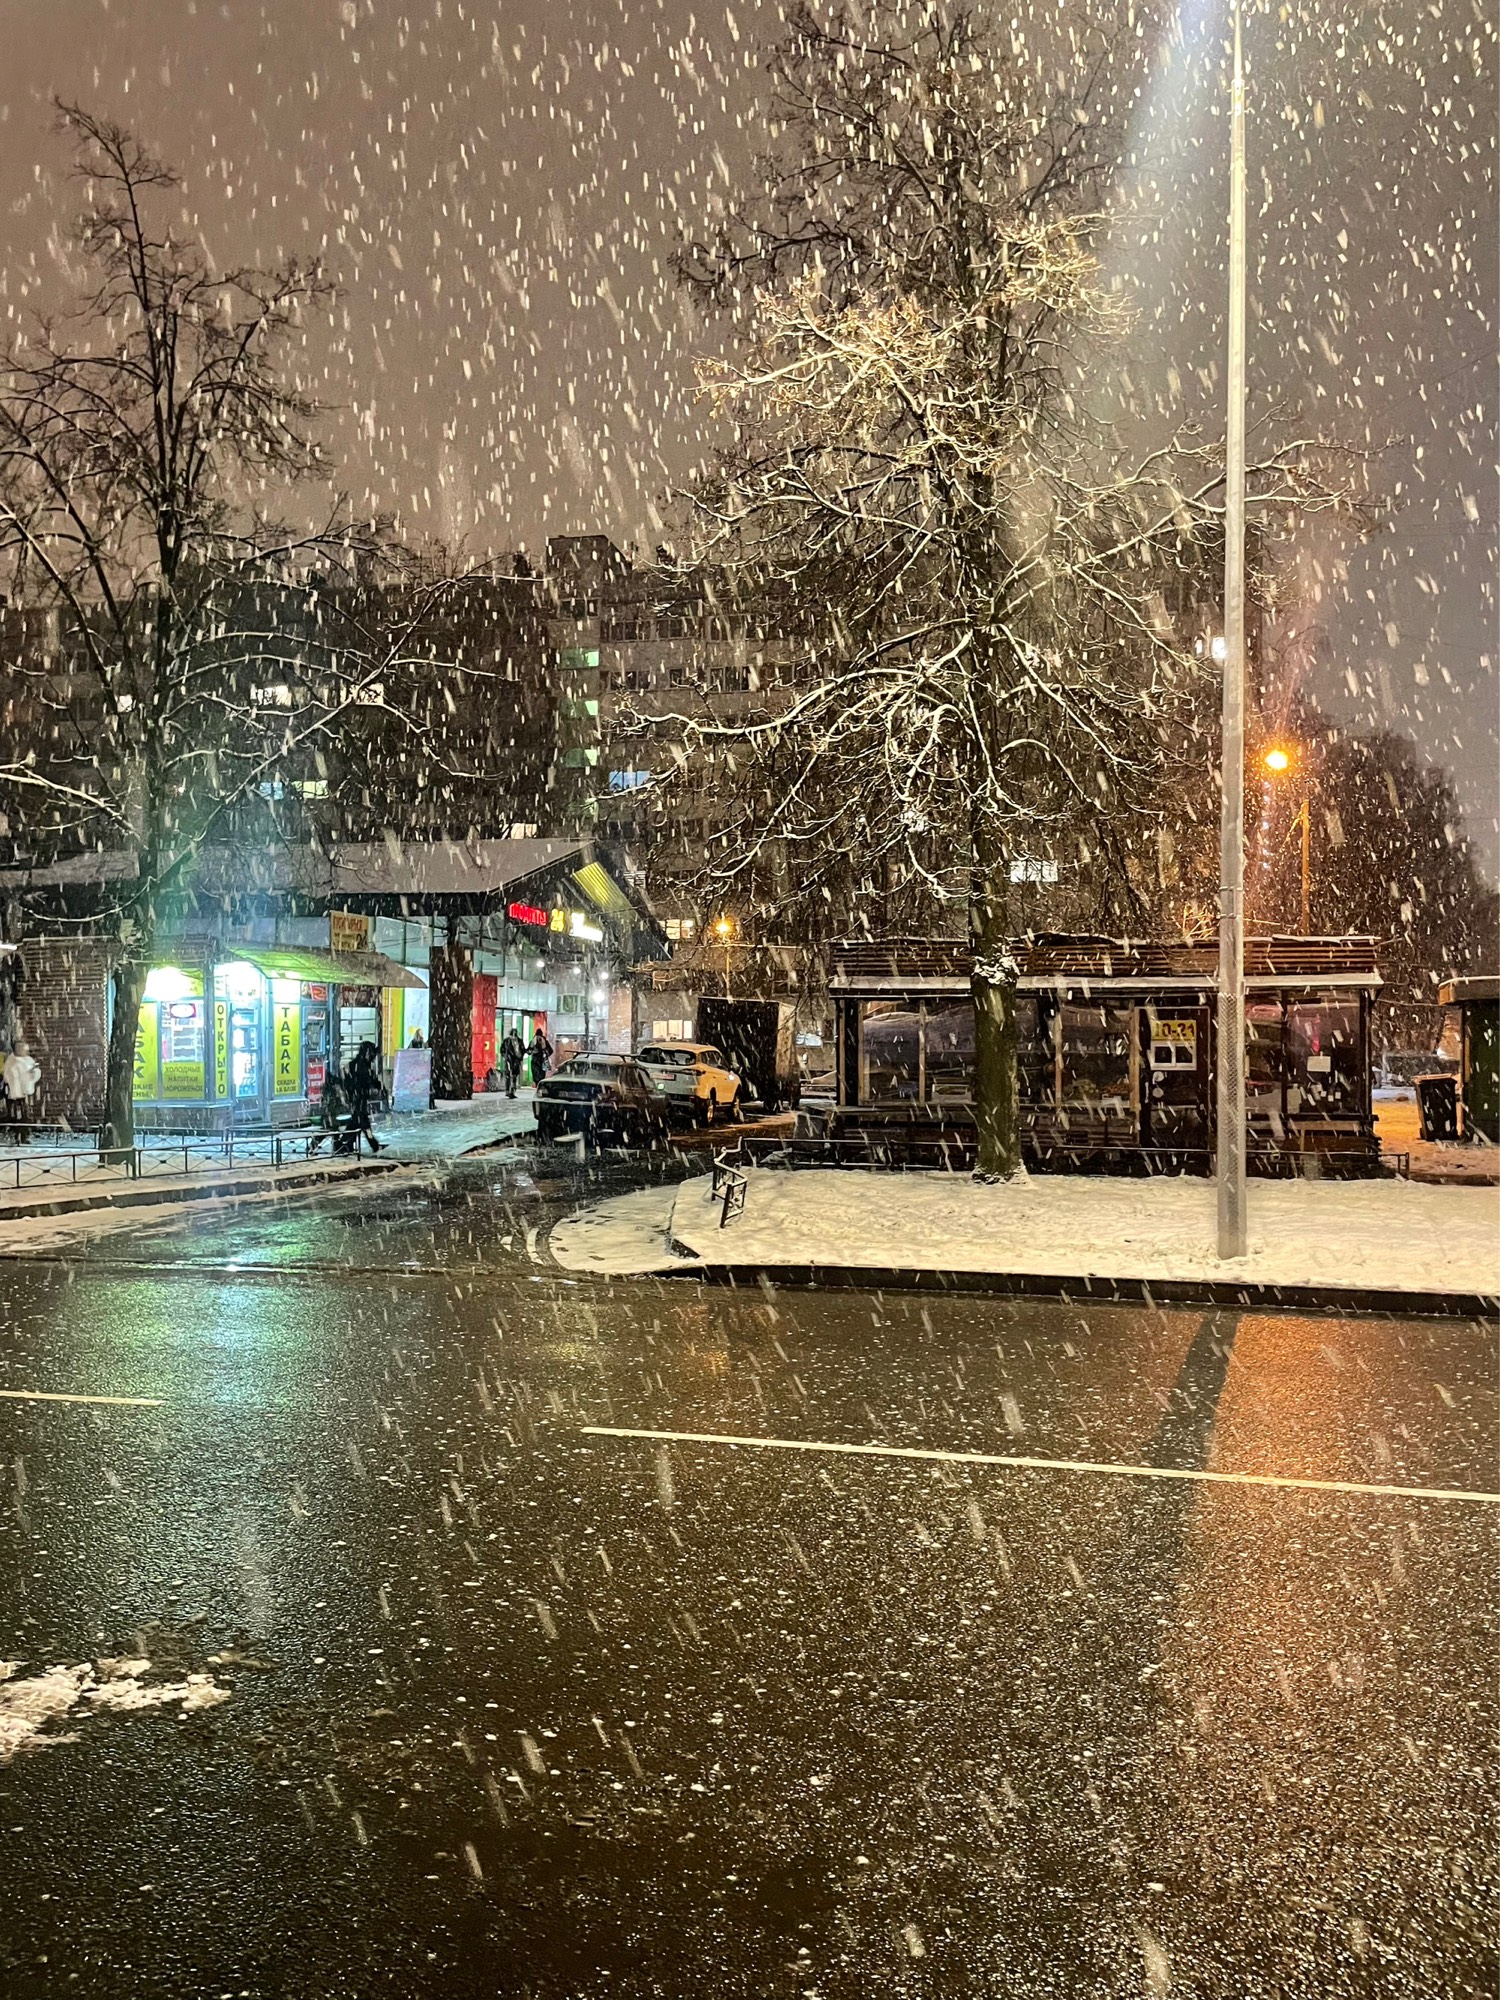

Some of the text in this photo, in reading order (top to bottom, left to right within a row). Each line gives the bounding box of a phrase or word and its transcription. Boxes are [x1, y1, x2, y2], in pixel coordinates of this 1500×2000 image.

[165, 1066, 201, 1074] ХОЛОДНЫЕ
[217, 1004, 226, 1094] ОТКРЫТО
[280, 1007, 291, 1074] ТАБАК
